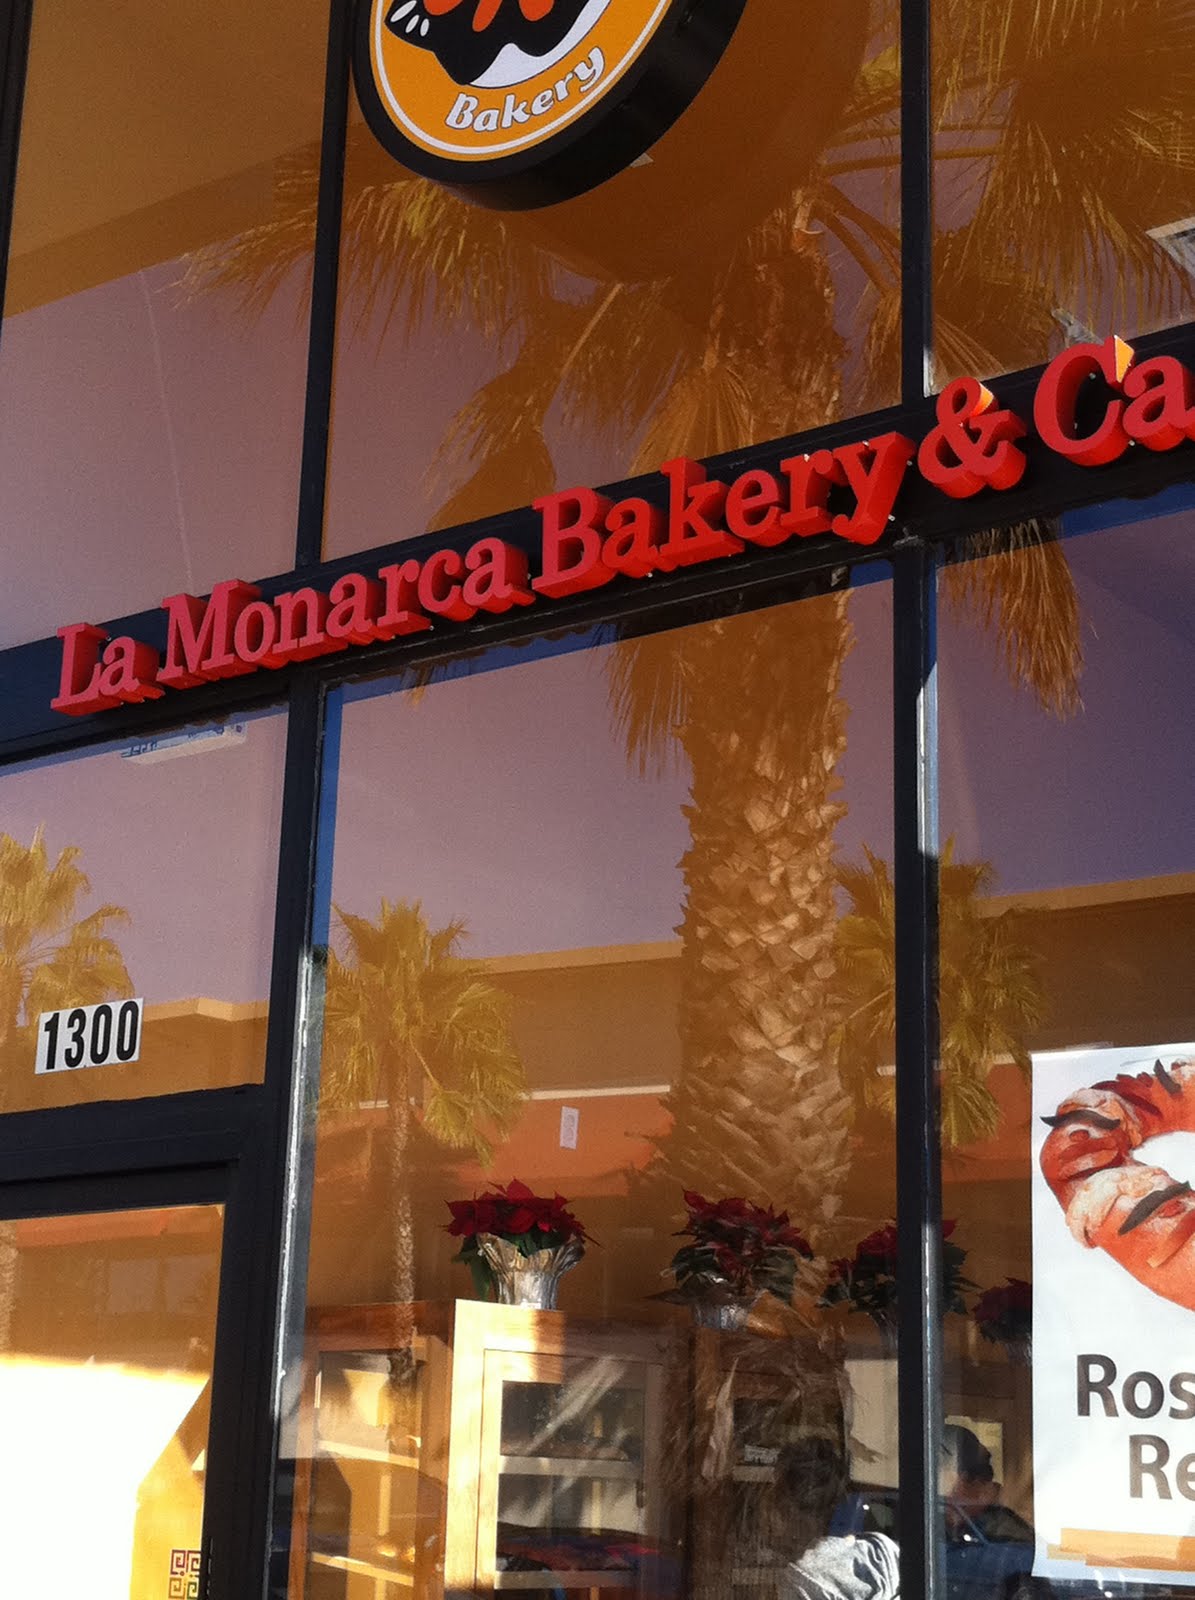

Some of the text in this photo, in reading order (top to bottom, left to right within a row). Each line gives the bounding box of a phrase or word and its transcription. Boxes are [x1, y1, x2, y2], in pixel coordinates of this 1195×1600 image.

[445, 45, 606, 133] Bakery
[50, 336, 1195, 712] La Monarca Bakery & Ca
[43, 1000, 140, 1071] 1300
[1075, 1353, 1195, 1420] Ros
